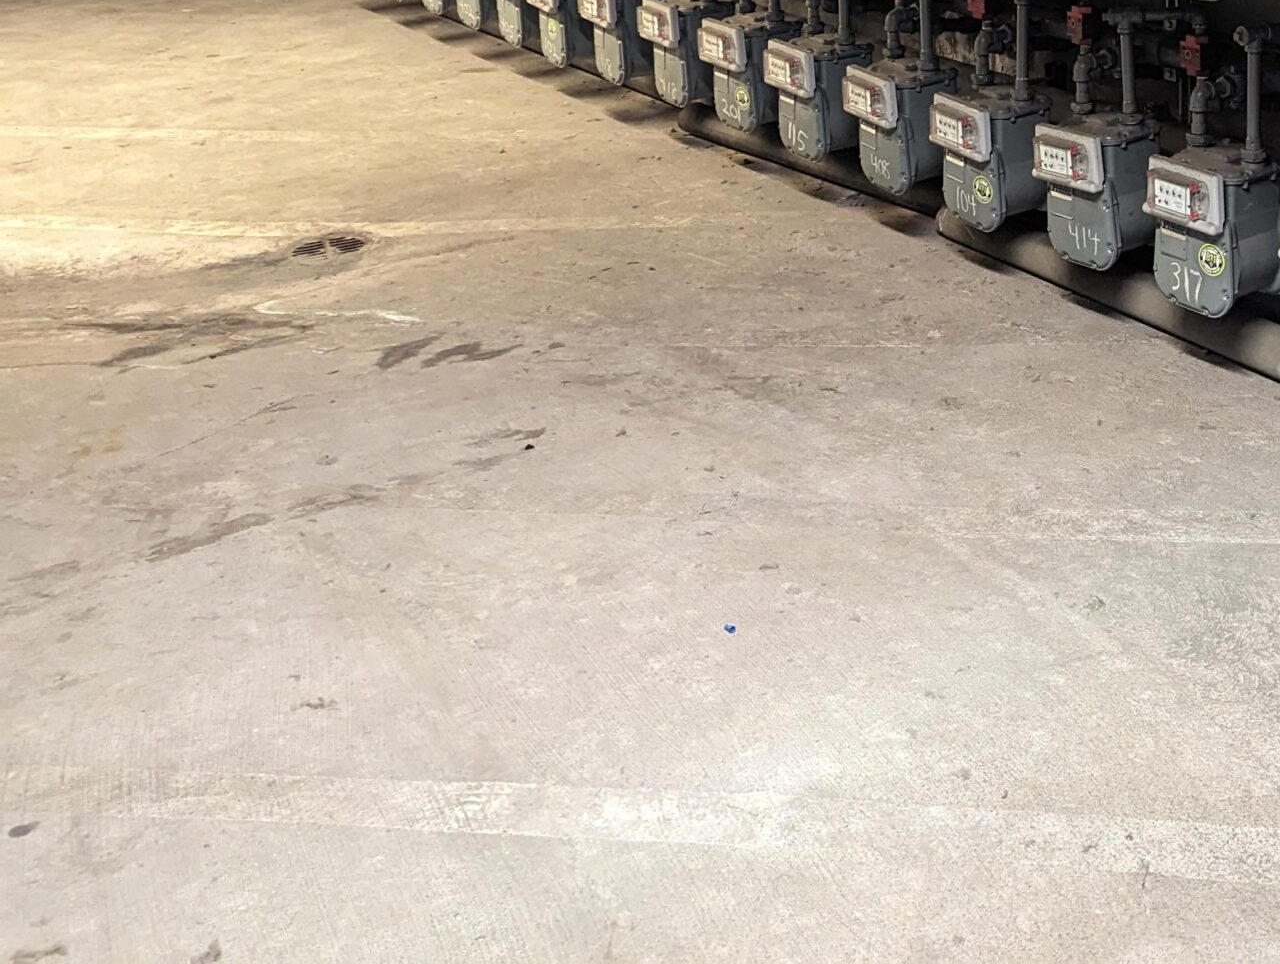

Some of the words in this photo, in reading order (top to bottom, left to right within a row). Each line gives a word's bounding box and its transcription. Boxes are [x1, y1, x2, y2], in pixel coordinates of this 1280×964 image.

[721, 98, 741, 122] 201
[788, 121, 809, 151] 115
[955, 185, 977, 217] 104
[1068, 222, 1101, 256] 414
[1170, 261, 1203, 305] 317
